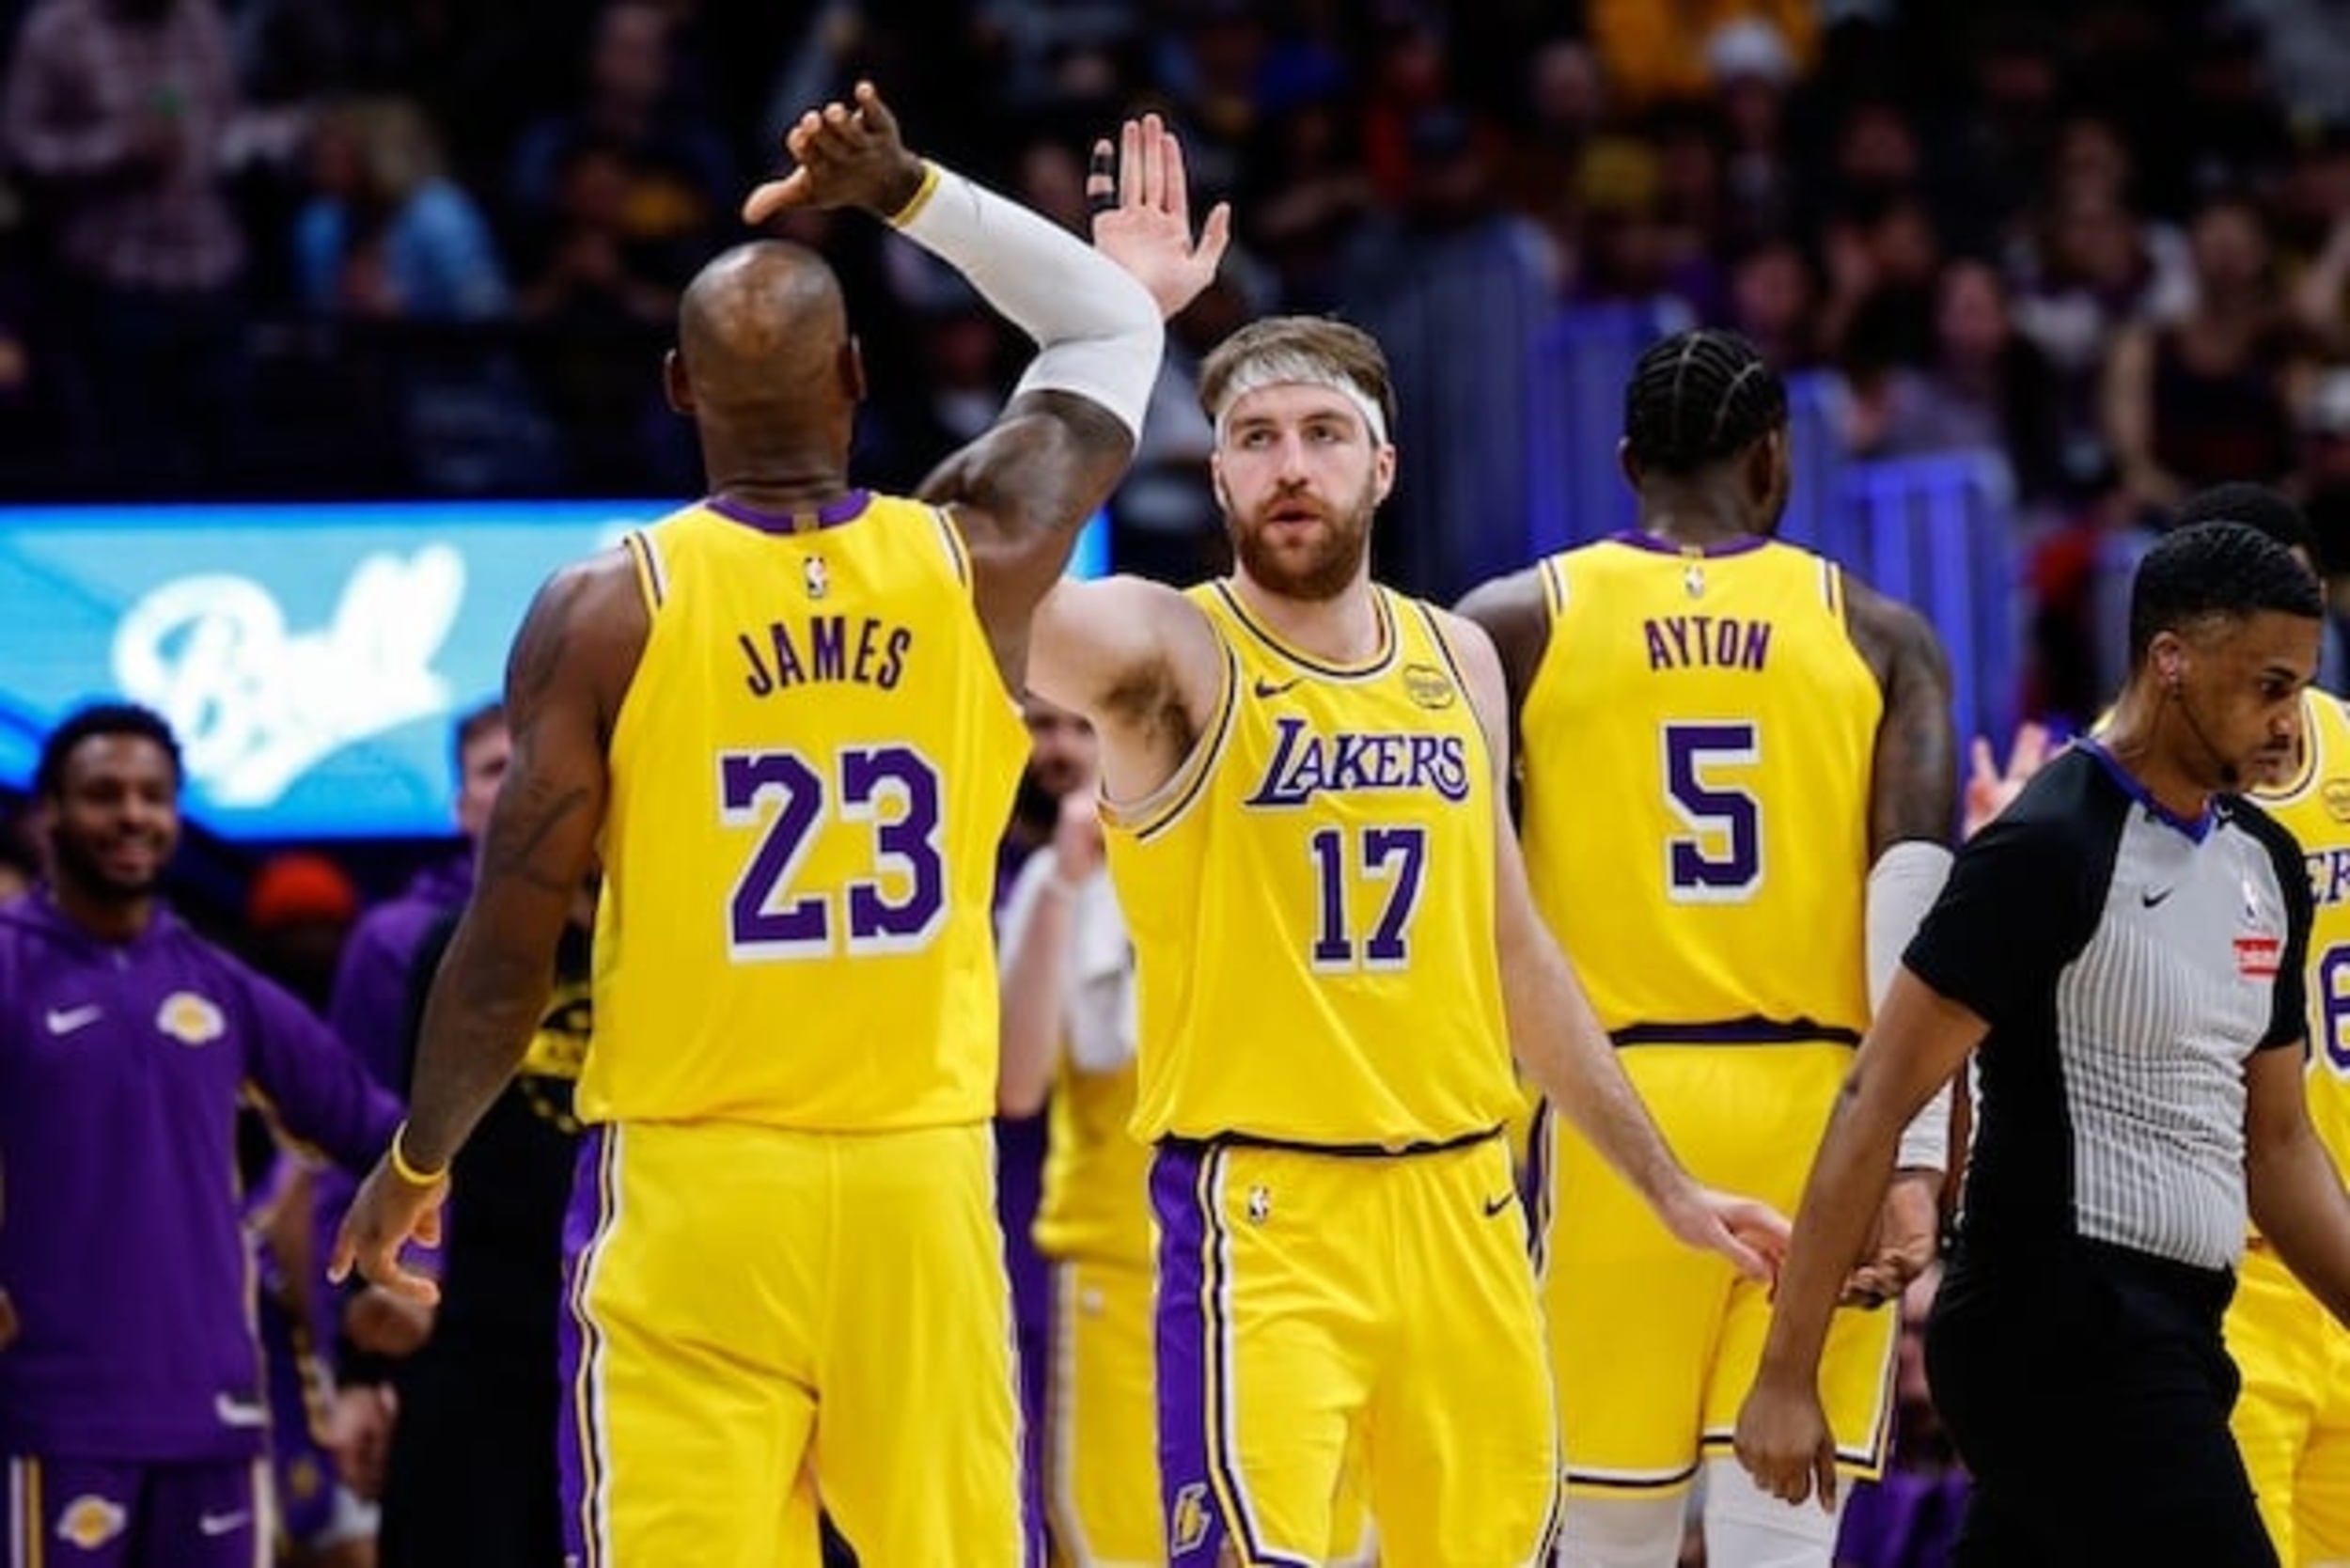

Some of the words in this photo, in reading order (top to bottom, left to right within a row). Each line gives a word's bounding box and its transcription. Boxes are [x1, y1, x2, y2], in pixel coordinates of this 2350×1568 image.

[739, 616, 912, 698] JAMES
[1644, 617, 1771, 671] AYTON
[1243, 717, 1470, 808] LAKERS
[1661, 718, 1763, 902] 5
[718, 745, 948, 961] 23
[1310, 826, 1427, 974] 17
